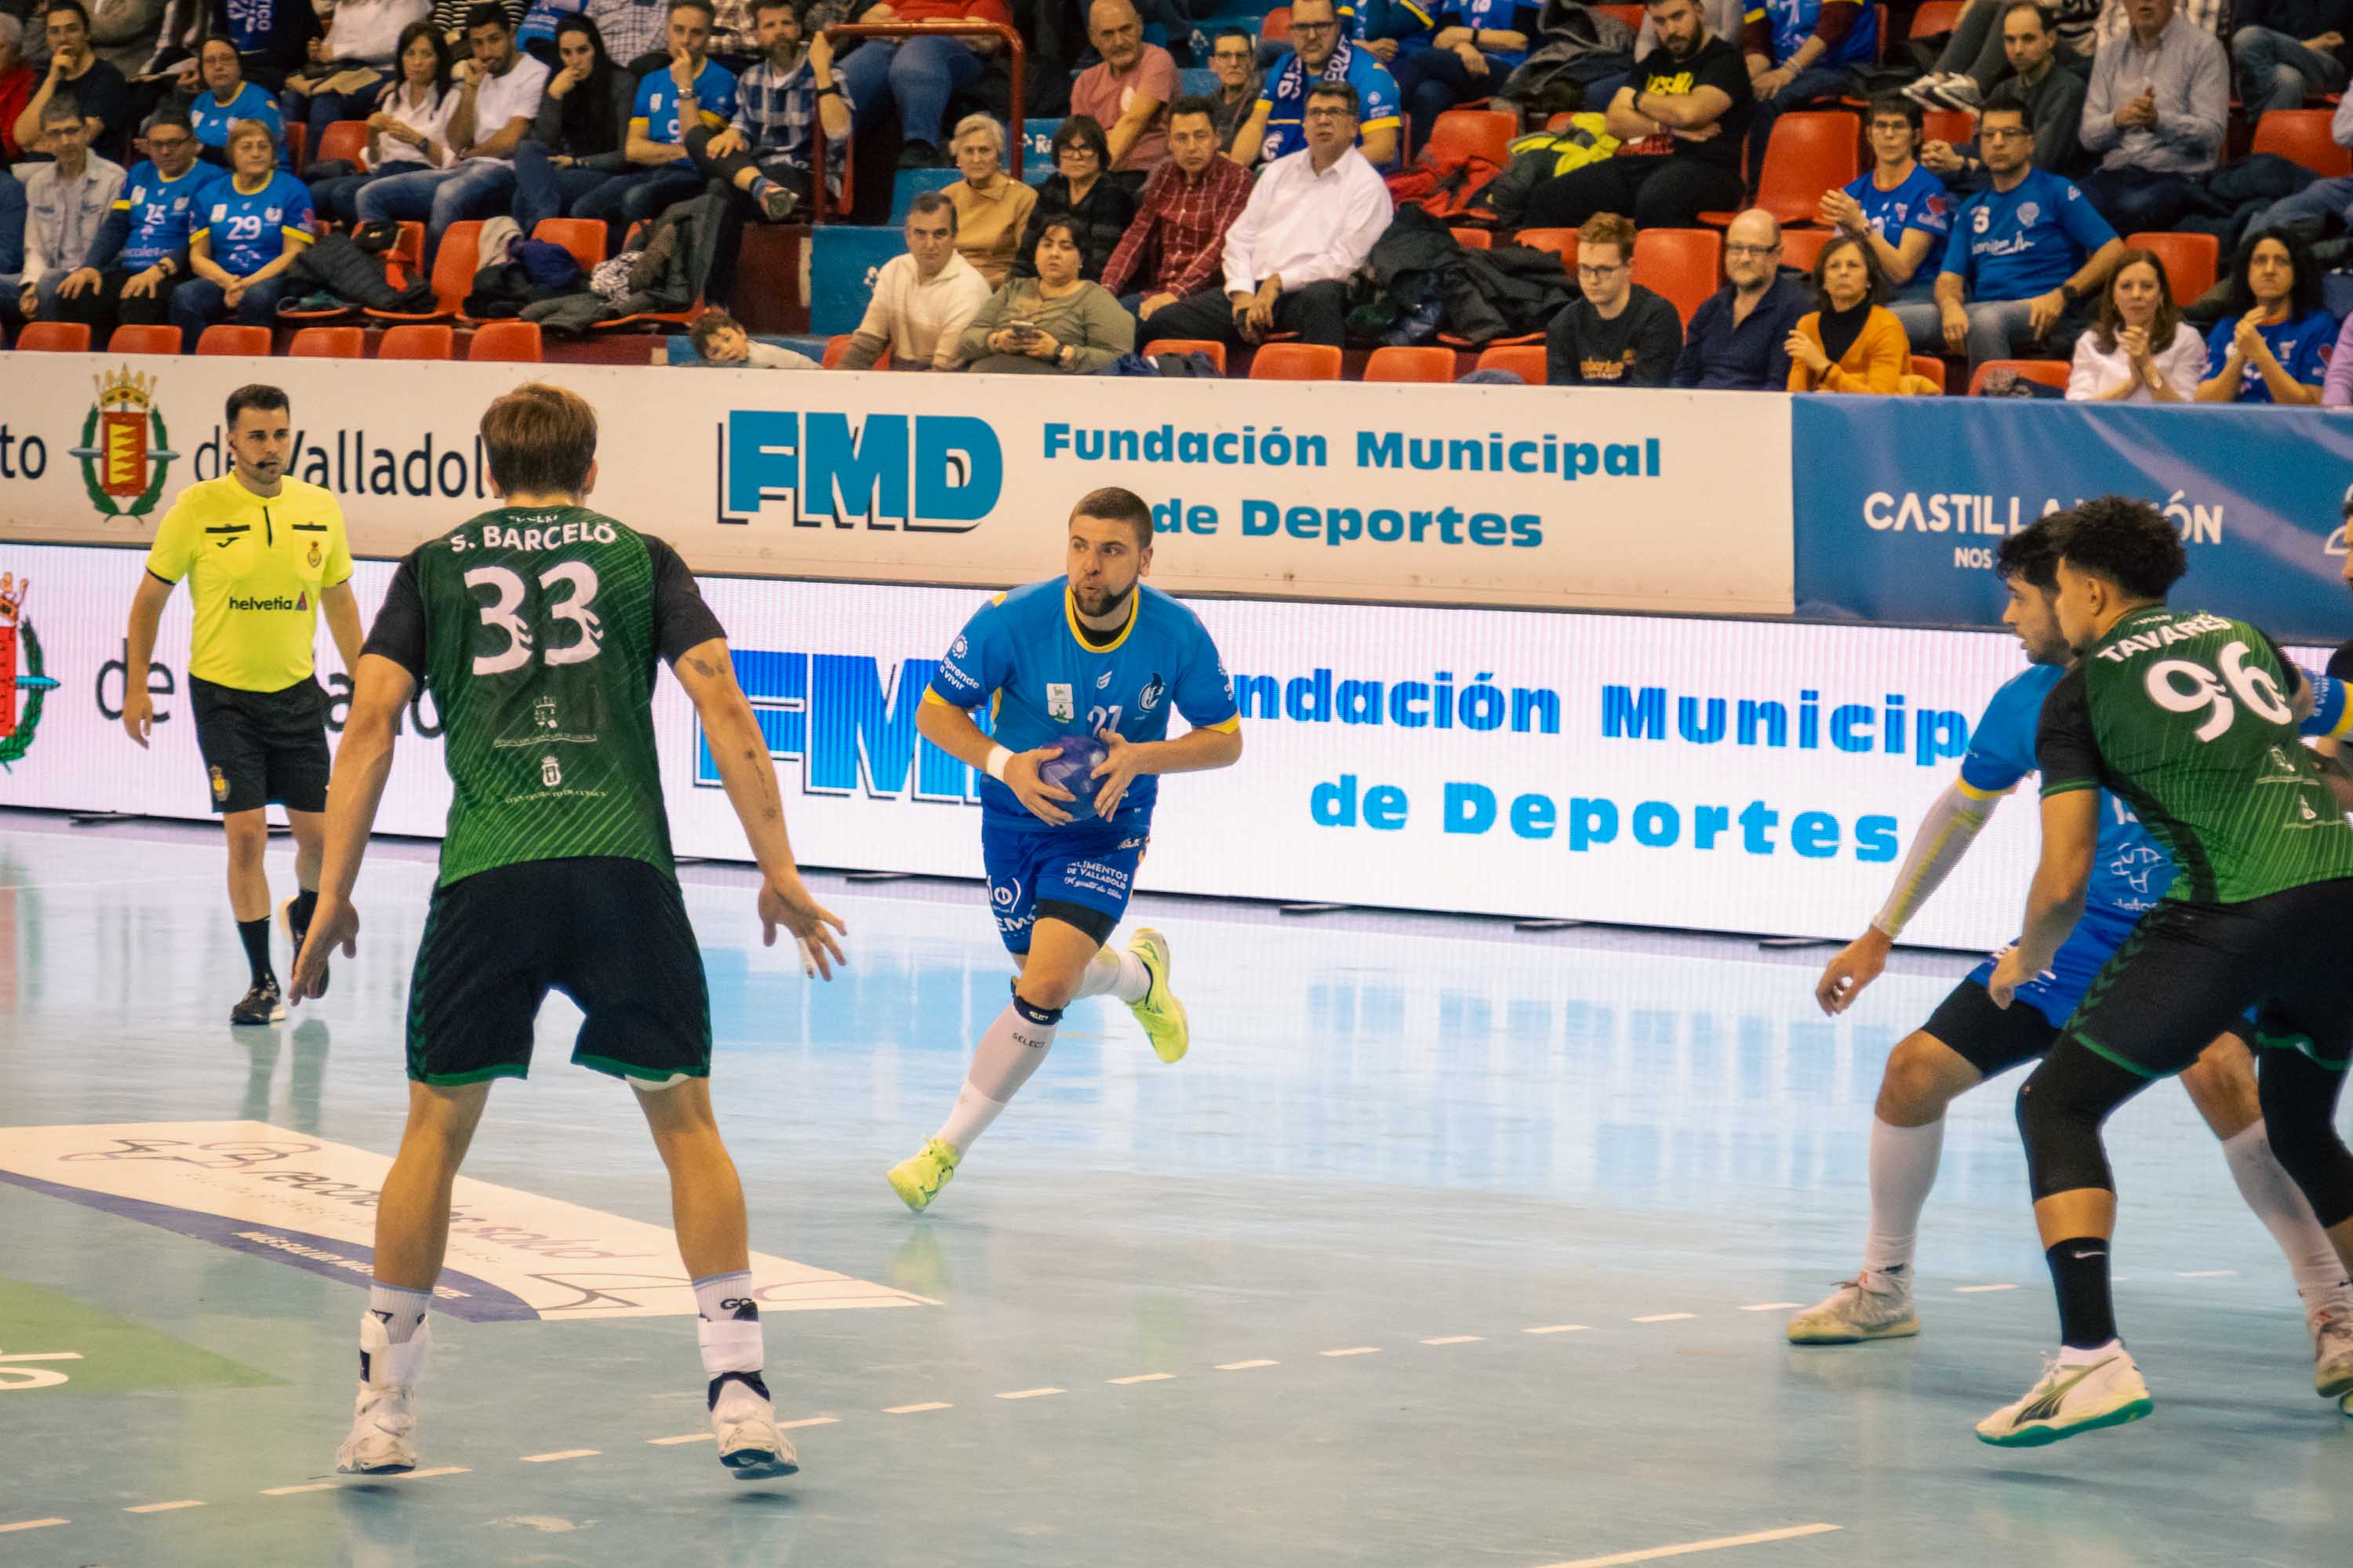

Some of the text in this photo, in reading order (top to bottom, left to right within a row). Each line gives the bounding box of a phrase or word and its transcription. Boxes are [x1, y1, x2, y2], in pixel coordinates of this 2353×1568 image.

[227, 216, 262, 240] 29
[0, 424, 46, 480] to
[718, 410, 1003, 533] FMD
[1043, 422, 1661, 481] Fundación Municipal
[450, 534, 475, 552] S.
[1152, 499, 1544, 548] de Deportes
[1955, 547, 1992, 569] NOS
[229, 596, 293, 611] helvetia
[464, 561, 604, 675] 33
[944, 657, 980, 689] aprende
[2147, 641, 2293, 743] 96
[1238, 669, 1970, 766] ndación Municip
[1310, 775, 1899, 864] de Deportes
[1067, 860, 1129, 882] ALIMENTOS
[1012, 1032, 1046, 1050] SELECT
